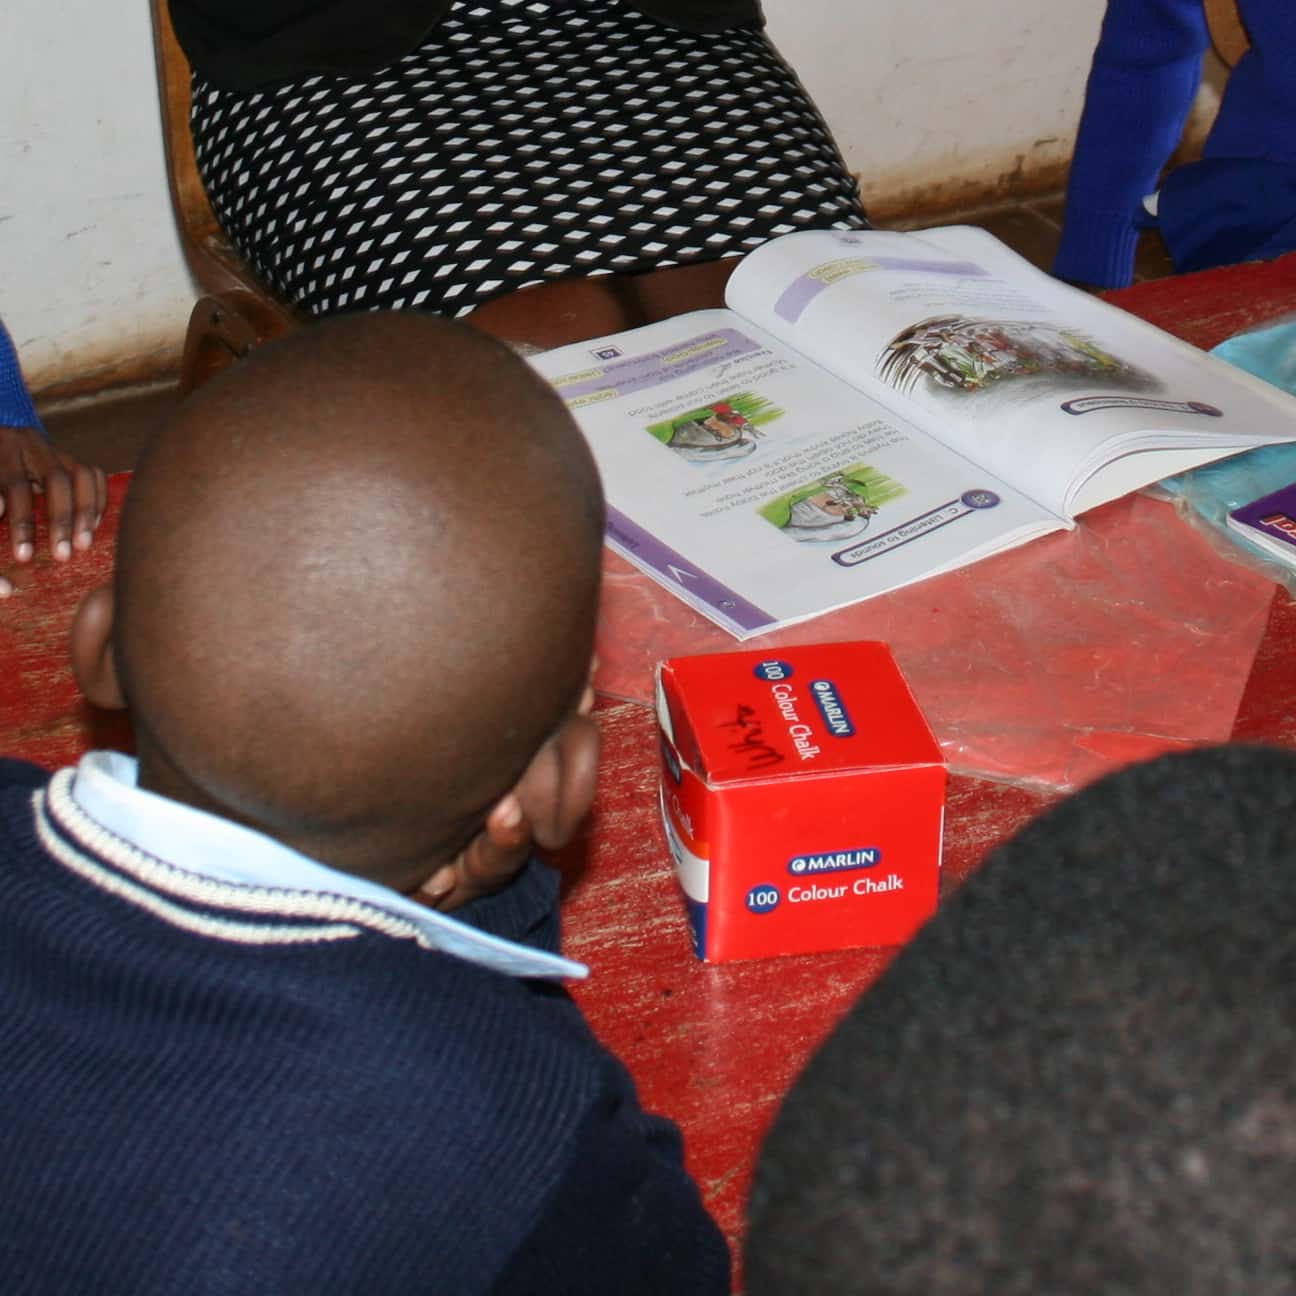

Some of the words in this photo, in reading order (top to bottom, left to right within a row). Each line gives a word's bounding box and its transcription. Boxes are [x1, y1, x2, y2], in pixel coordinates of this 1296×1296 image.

[762, 661, 784, 681] 100
[771, 684, 800, 722] Colour
[817, 689, 850, 735] MARLIN
[789, 724, 820, 760] Chalk
[808, 851, 874, 871] MARLIN
[748, 891, 778, 907] 100
[788, 884, 848, 904] Colour
[853, 874, 903, 896] Chalk
